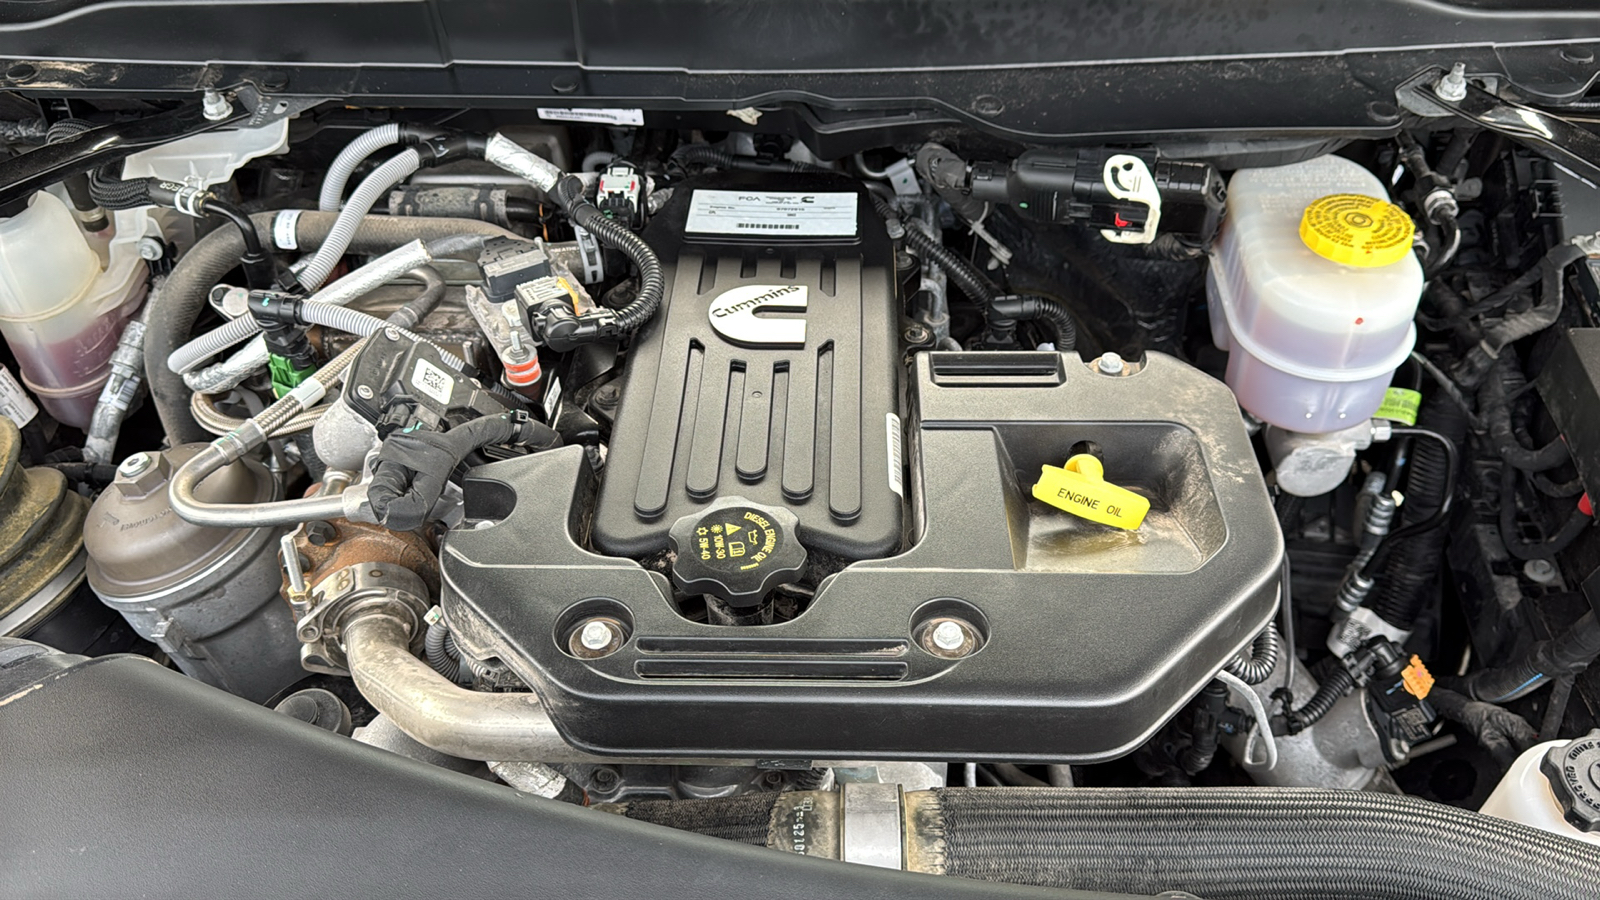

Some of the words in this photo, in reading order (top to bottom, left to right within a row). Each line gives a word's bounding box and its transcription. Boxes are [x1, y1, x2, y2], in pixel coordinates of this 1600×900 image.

[712, 285, 800, 319] Cummins
[1057, 487, 1100, 510] ENGINE
[1106, 505, 1122, 518] OIL
[743, 511, 770, 530] DIESEL
[699, 537, 711, 560] 5W-40
[713, 534, 726, 559] 10W-30
[761, 528, 777, 554] ENGINE
[750, 551, 767, 562] OIL
